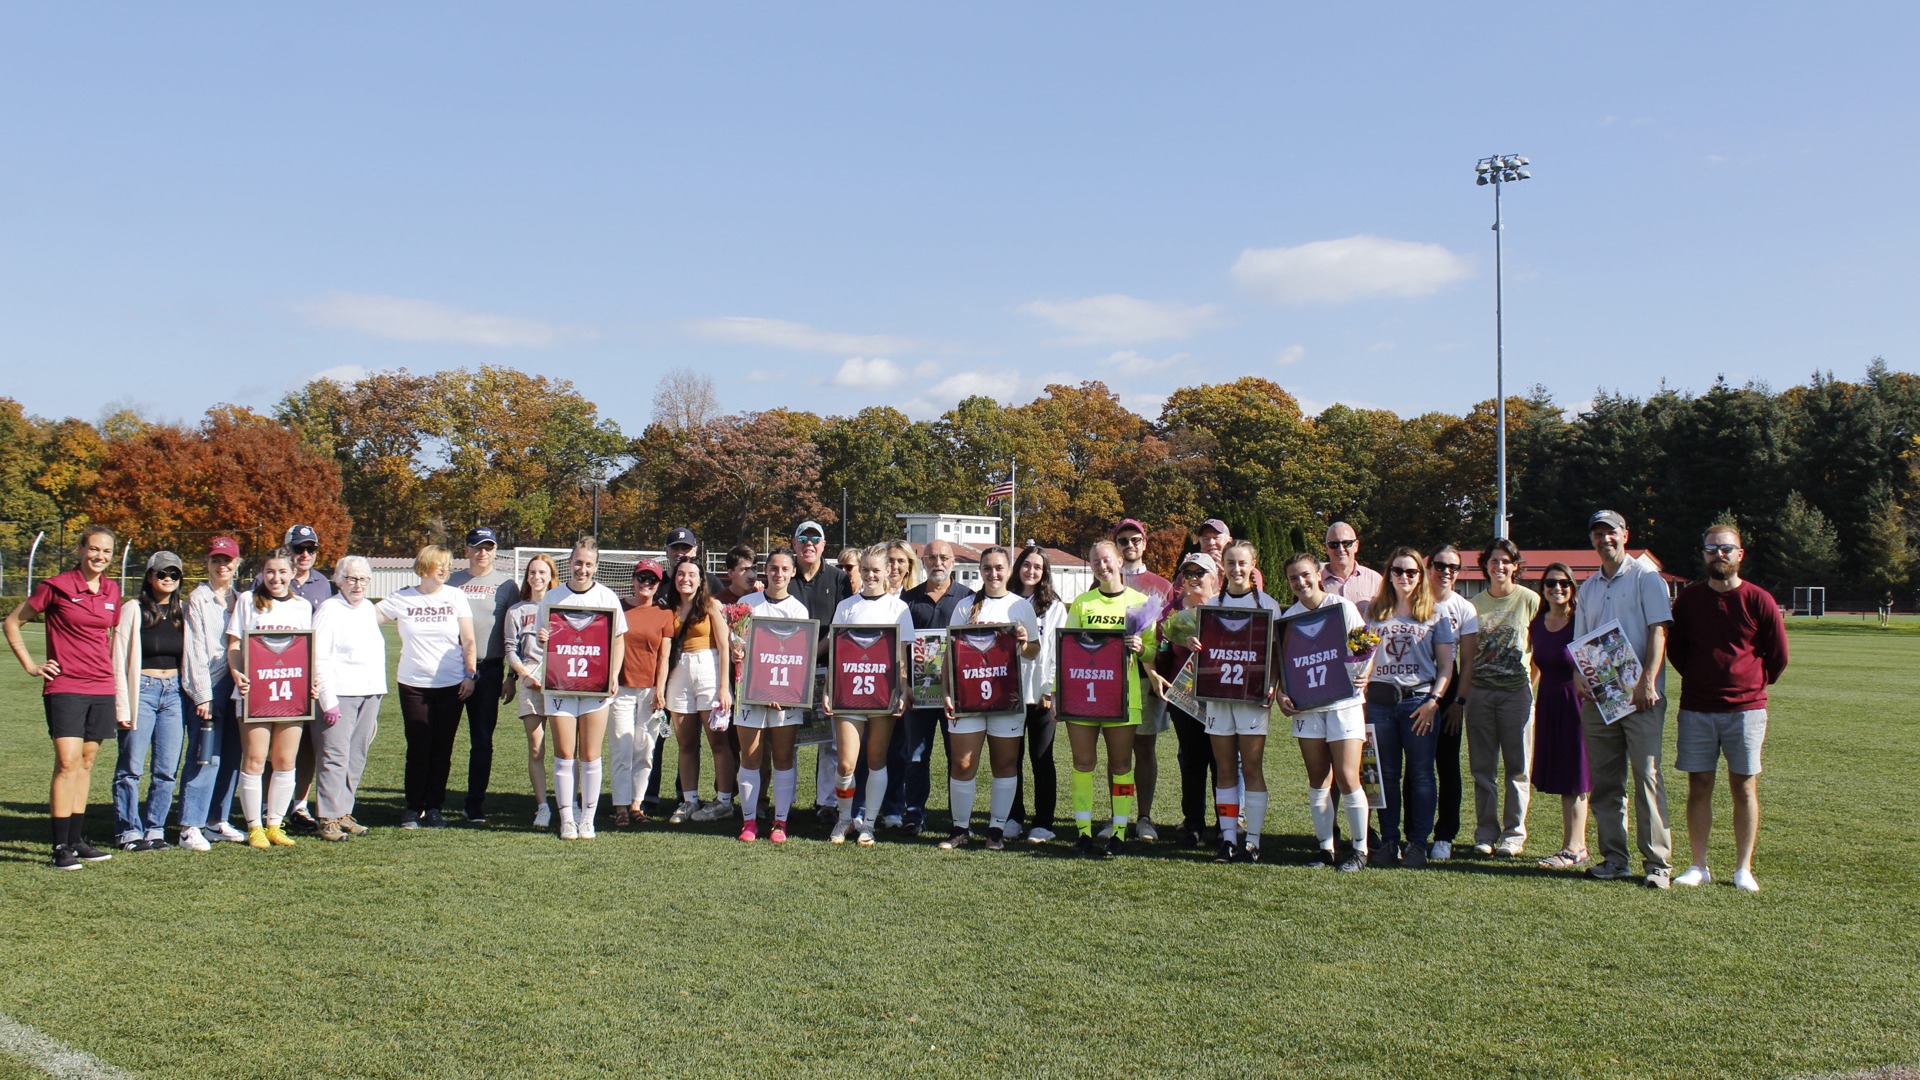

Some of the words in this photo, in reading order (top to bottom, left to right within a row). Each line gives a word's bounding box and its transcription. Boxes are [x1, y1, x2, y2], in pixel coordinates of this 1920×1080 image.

[406, 605, 454, 616] VASSAR
[1086, 615, 1125, 625] VASSA
[556, 644, 601, 656] VASSAR
[913, 637, 925, 673] 2024
[1208, 648, 1257, 662] VASSAR
[759, 652, 803, 665] VASSAR
[1292, 648, 1338, 668] VASSAR
[257, 667, 302, 680] VASSAR
[566, 657, 589, 678] 12
[842, 662, 887, 674] VASSAR
[962, 665, 1008, 679] VASSAR
[1069, 668, 1114, 680] VASSAR
[1220, 663, 1244, 685] 22
[1376, 663, 1420, 676] SOCCER
[769, 666, 790, 687] 11
[1306, 664, 1327, 689] 17
[268, 680, 293, 701] 14
[852, 675, 876, 696] 25
[980, 680, 993, 700] 9
[1086, 681, 1097, 702] 1
[1119, 785, 1130, 796] C
